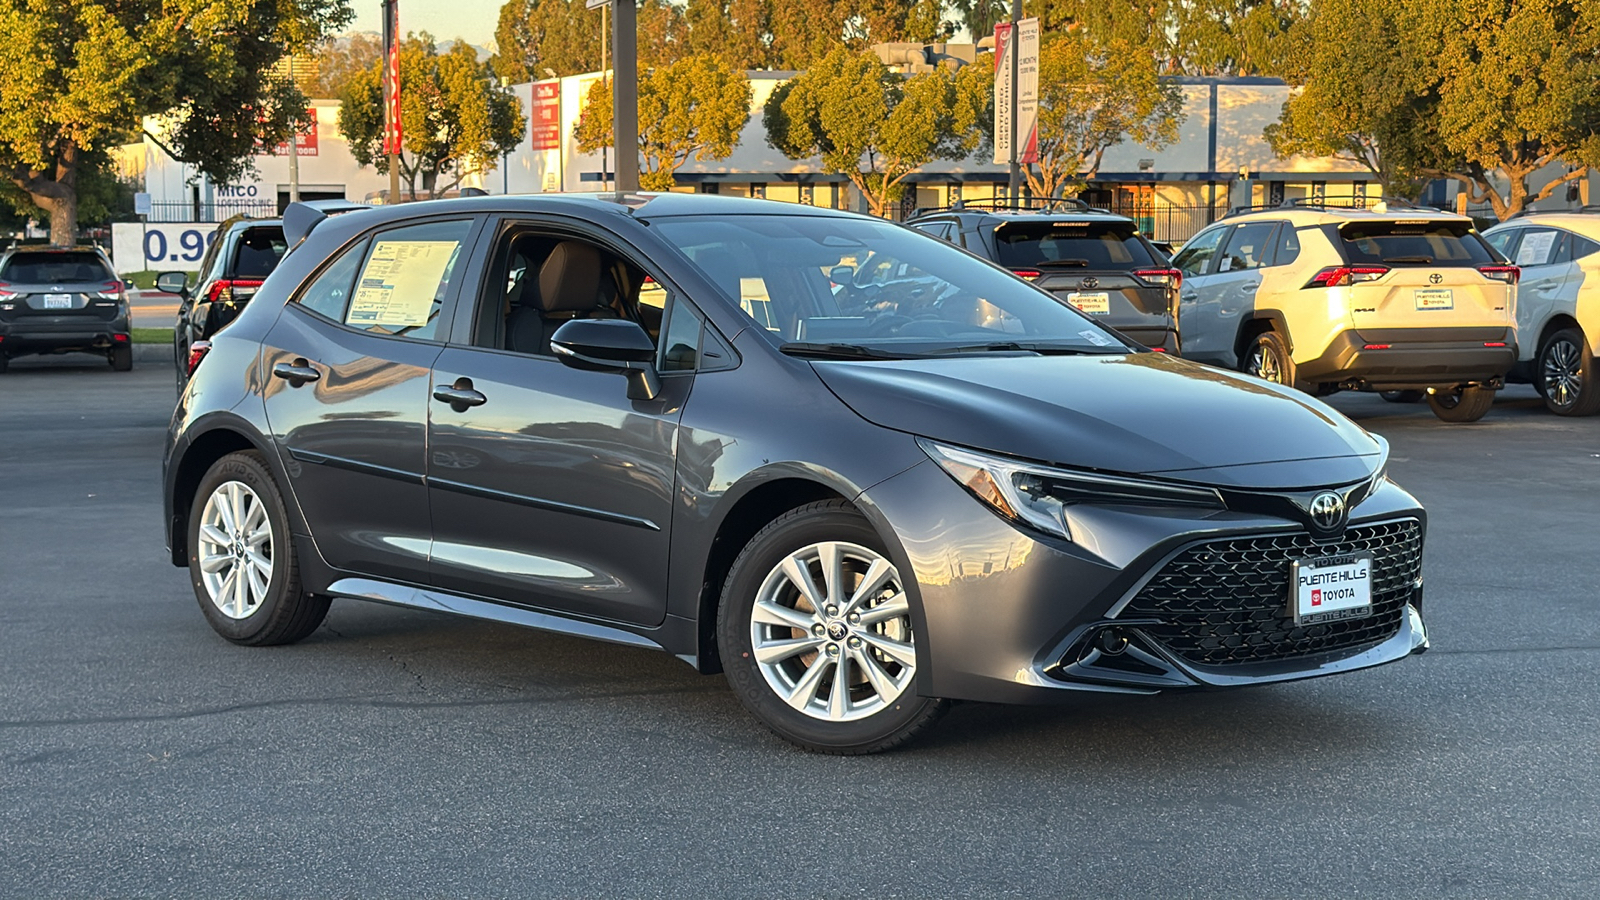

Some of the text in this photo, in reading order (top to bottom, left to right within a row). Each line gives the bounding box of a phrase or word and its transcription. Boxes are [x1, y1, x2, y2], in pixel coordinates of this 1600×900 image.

[275, 145, 317, 155] Batroom
[217, 185, 258, 197] MICO
[220, 462, 247, 475] AVID
[1316, 556, 1355, 567] TOYOTA
[1299, 568, 1367, 587] PUENTE HILLS
[1322, 587, 1355, 601] TOYOTA
[1301, 607, 1369, 624] PUENTE HILLS
